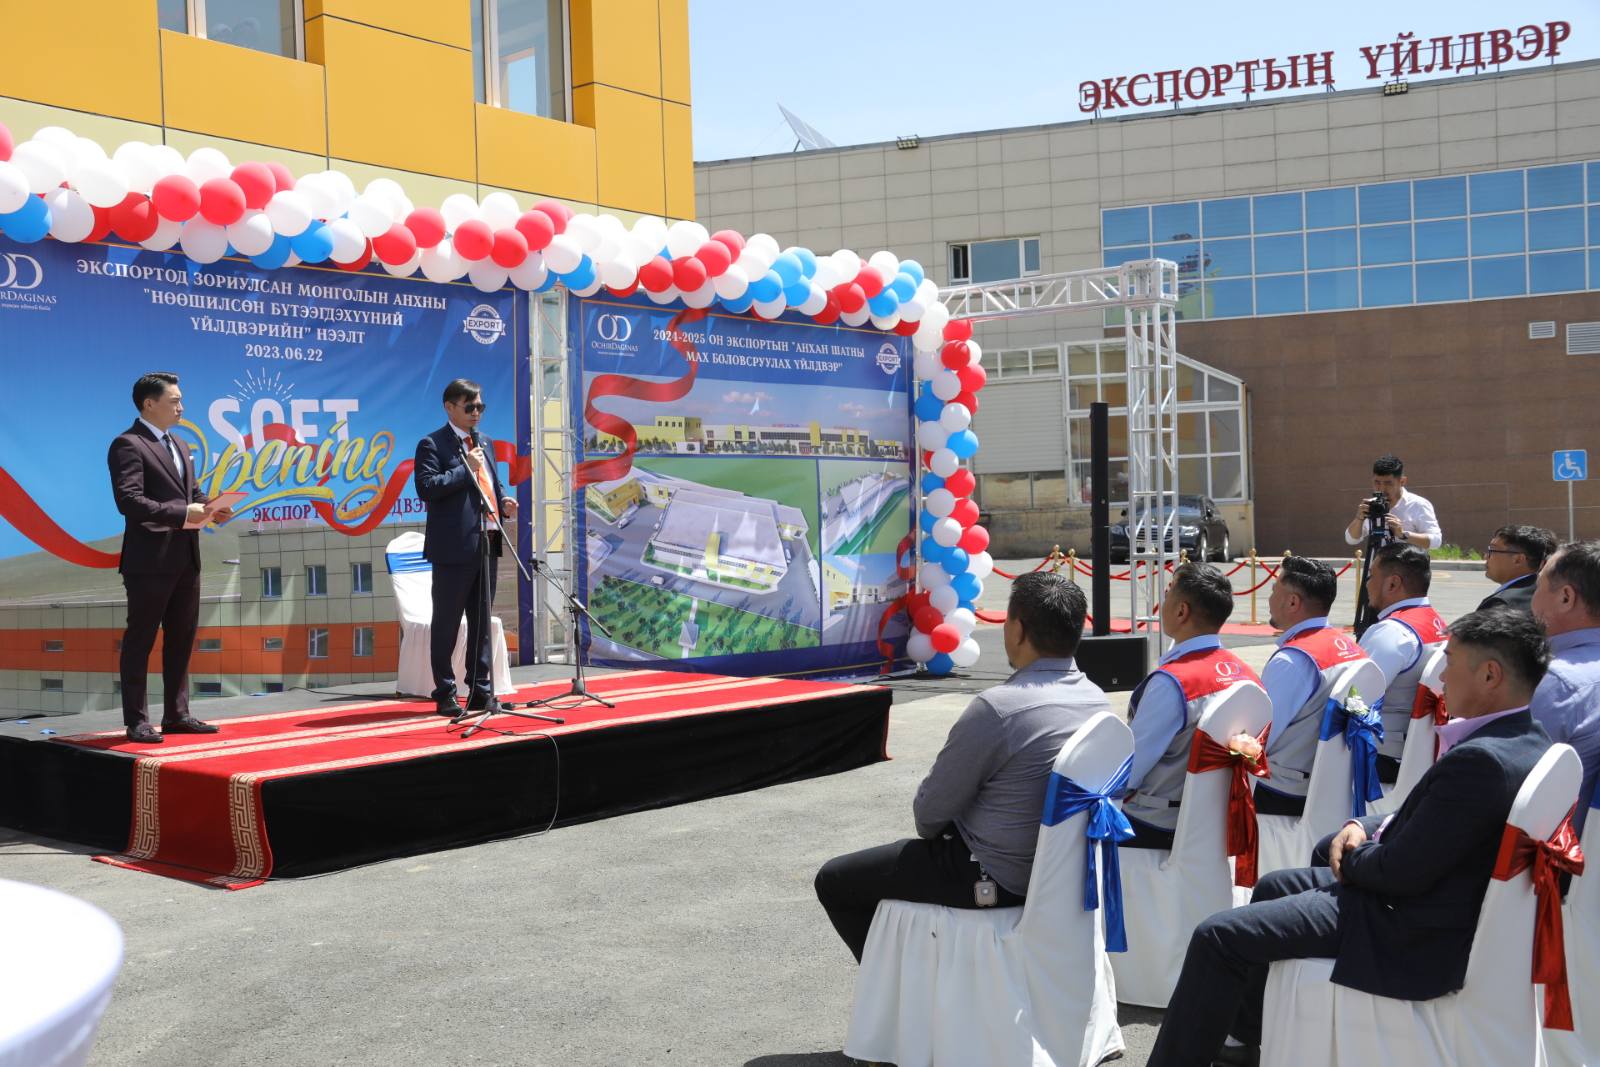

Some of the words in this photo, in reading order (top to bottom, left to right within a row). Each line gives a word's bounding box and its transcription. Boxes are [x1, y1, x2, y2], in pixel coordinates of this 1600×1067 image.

[1078, 50, 1336, 113] ЭКСПОРТЫН
[1359, 20, 1571, 80] ҮЙЛДВЭР
[76, 259, 189, 286] ЭКСПОРТОД
[193, 271, 292, 295] ЗОРИУЛСАН
[298, 284, 389, 305] МОНГОЛЫН
[393, 293, 447, 310] АНХНЫ
[0, 290, 57, 304] RDAGINAS
[143, 287, 265, 315] "НӨӨШИЛСӨН
[271, 302, 404, 327] БҮТЭЭГДЭХҮҮНИЙ
[468, 319, 501, 330] EXPORT
[316, 328, 366, 344] НЭЭЛТ
[653, 329, 706, 344] 2024-2025
[708, 334, 723, 346] ОН
[726, 336, 789, 352] ЭКСПОРТЫН
[831, 345, 865, 358] ШАТНЫ
[245, 343, 323, 362] 2023.06.22
[686, 350, 709, 363] МАХ
[712, 353, 792, 370] БОЛОВСРУУЛАХ
